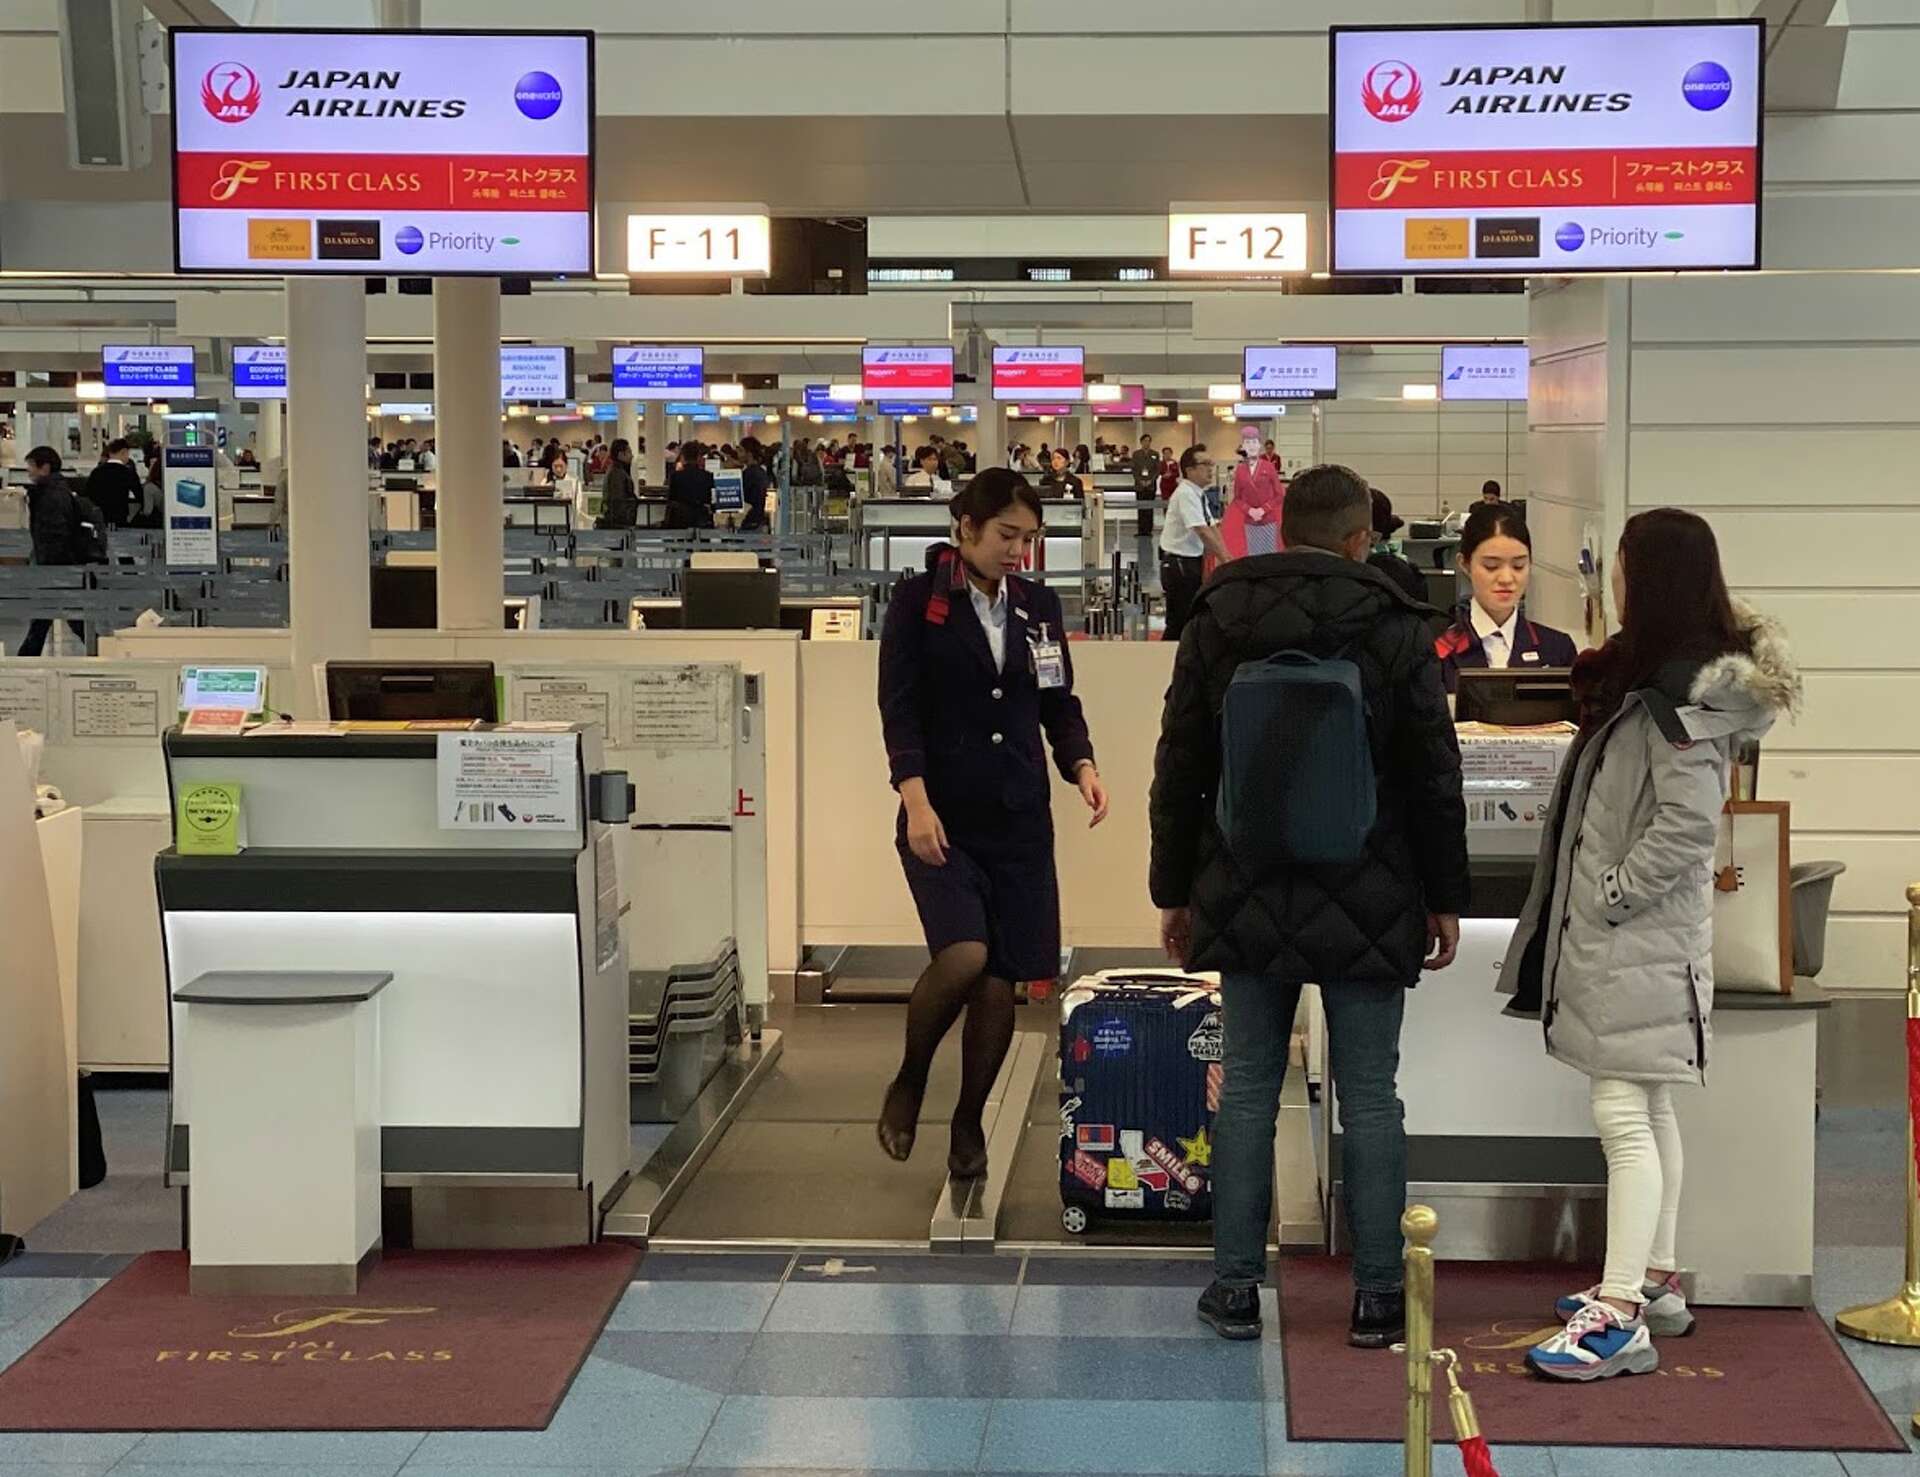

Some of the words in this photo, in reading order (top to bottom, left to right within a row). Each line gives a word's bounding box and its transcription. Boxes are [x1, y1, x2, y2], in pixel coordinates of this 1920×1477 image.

[278, 71, 401, 89] JAPAN
[1440, 65, 1567, 86] JAPAN
[1683, 80, 1731, 92] oneworld
[516, 91, 561, 101] oneworld
[1446, 92, 1633, 114] AIRLINES
[216, 105, 251, 117] JAL
[285, 98, 467, 118] AIRLINES
[1377, 103, 1411, 116] JAL
[461, 167, 577, 183] ファーストクラス
[1625, 159, 1745, 176] ファーストクラス
[275, 173, 342, 191] FIRST
[347, 174, 421, 192] CLASS
[1433, 170, 1500, 189] FIRST
[1508, 168, 1583, 188] CLASS
[323, 236, 375, 246] DIAMOND
[429, 231, 495, 253] Priority
[1482, 234, 1535, 243] DIAMOND
[1590, 227, 1658, 248] Priority
[734, 788, 755, 816] 上
[1148, 1140, 1192, 1182] SMILE
[155, 1351, 288, 1362] FIRST
[303, 1351, 453, 1362] CLASS
